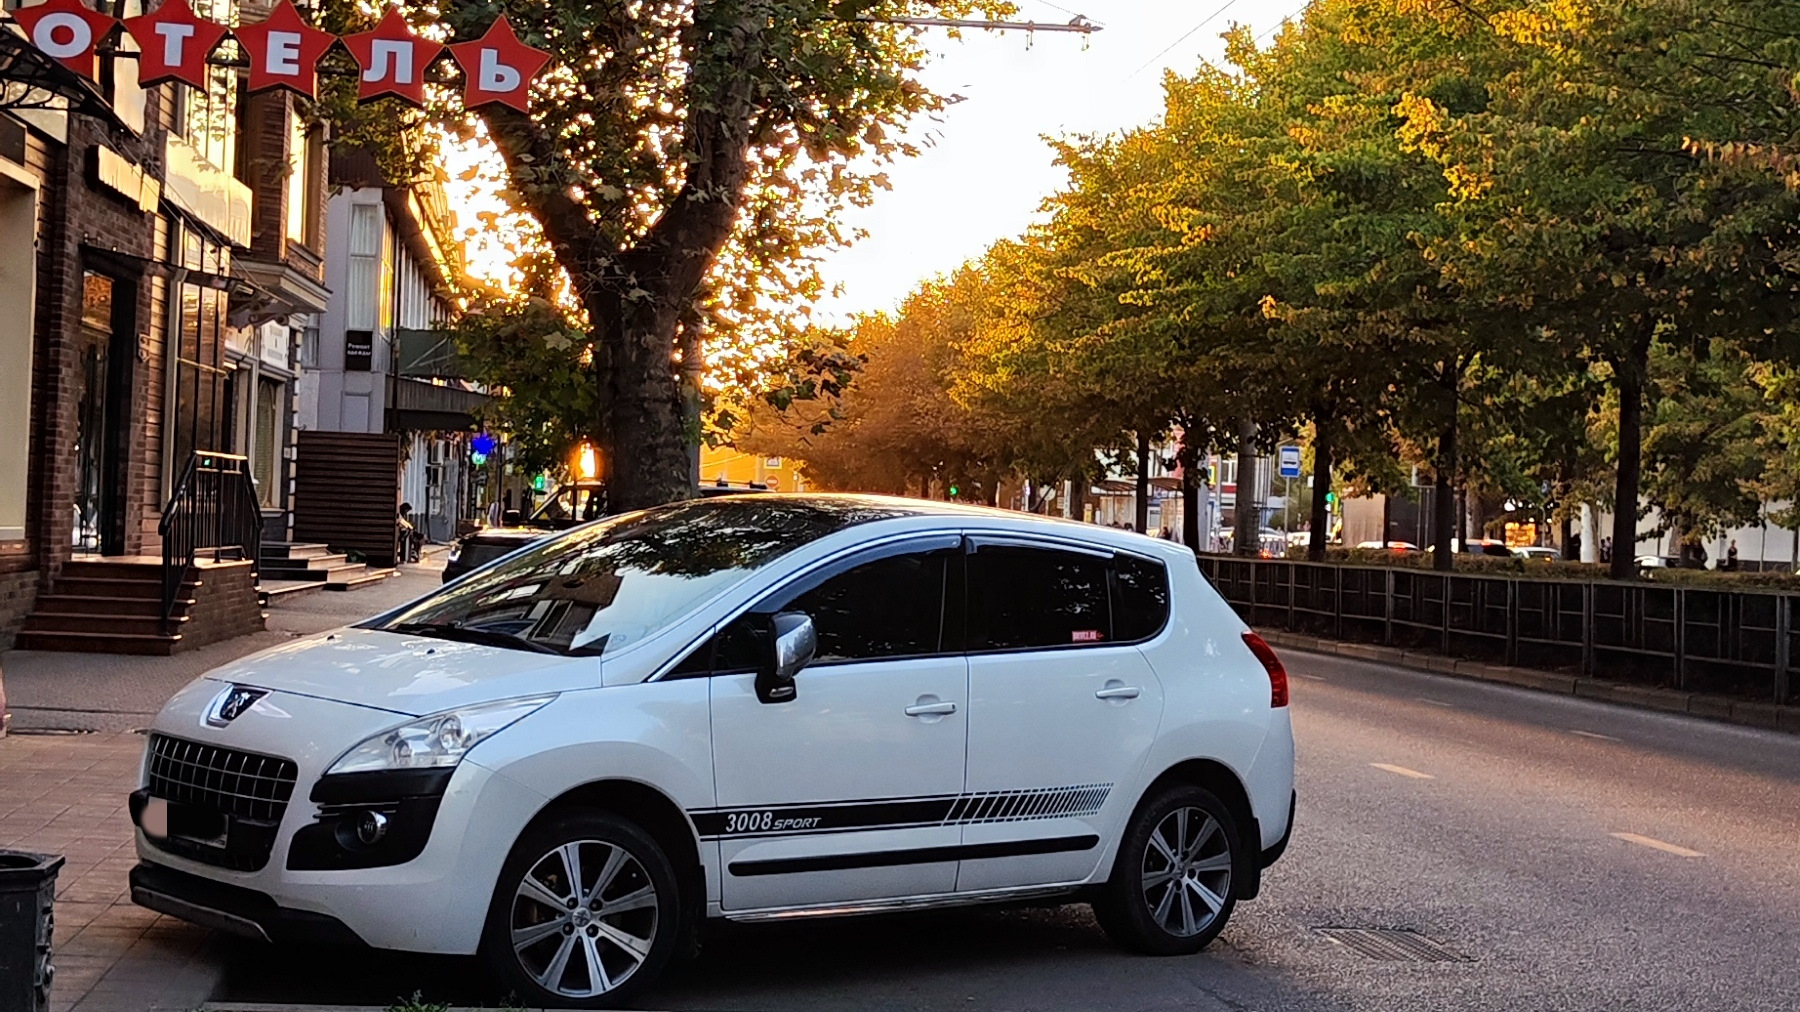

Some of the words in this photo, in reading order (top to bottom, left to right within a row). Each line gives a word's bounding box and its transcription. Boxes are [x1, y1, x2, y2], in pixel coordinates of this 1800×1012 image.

[33, 12, 521, 92] ОТЕЛЬ
[725, 811, 773, 832] 3008
[772, 817, 822, 830] SPORT
